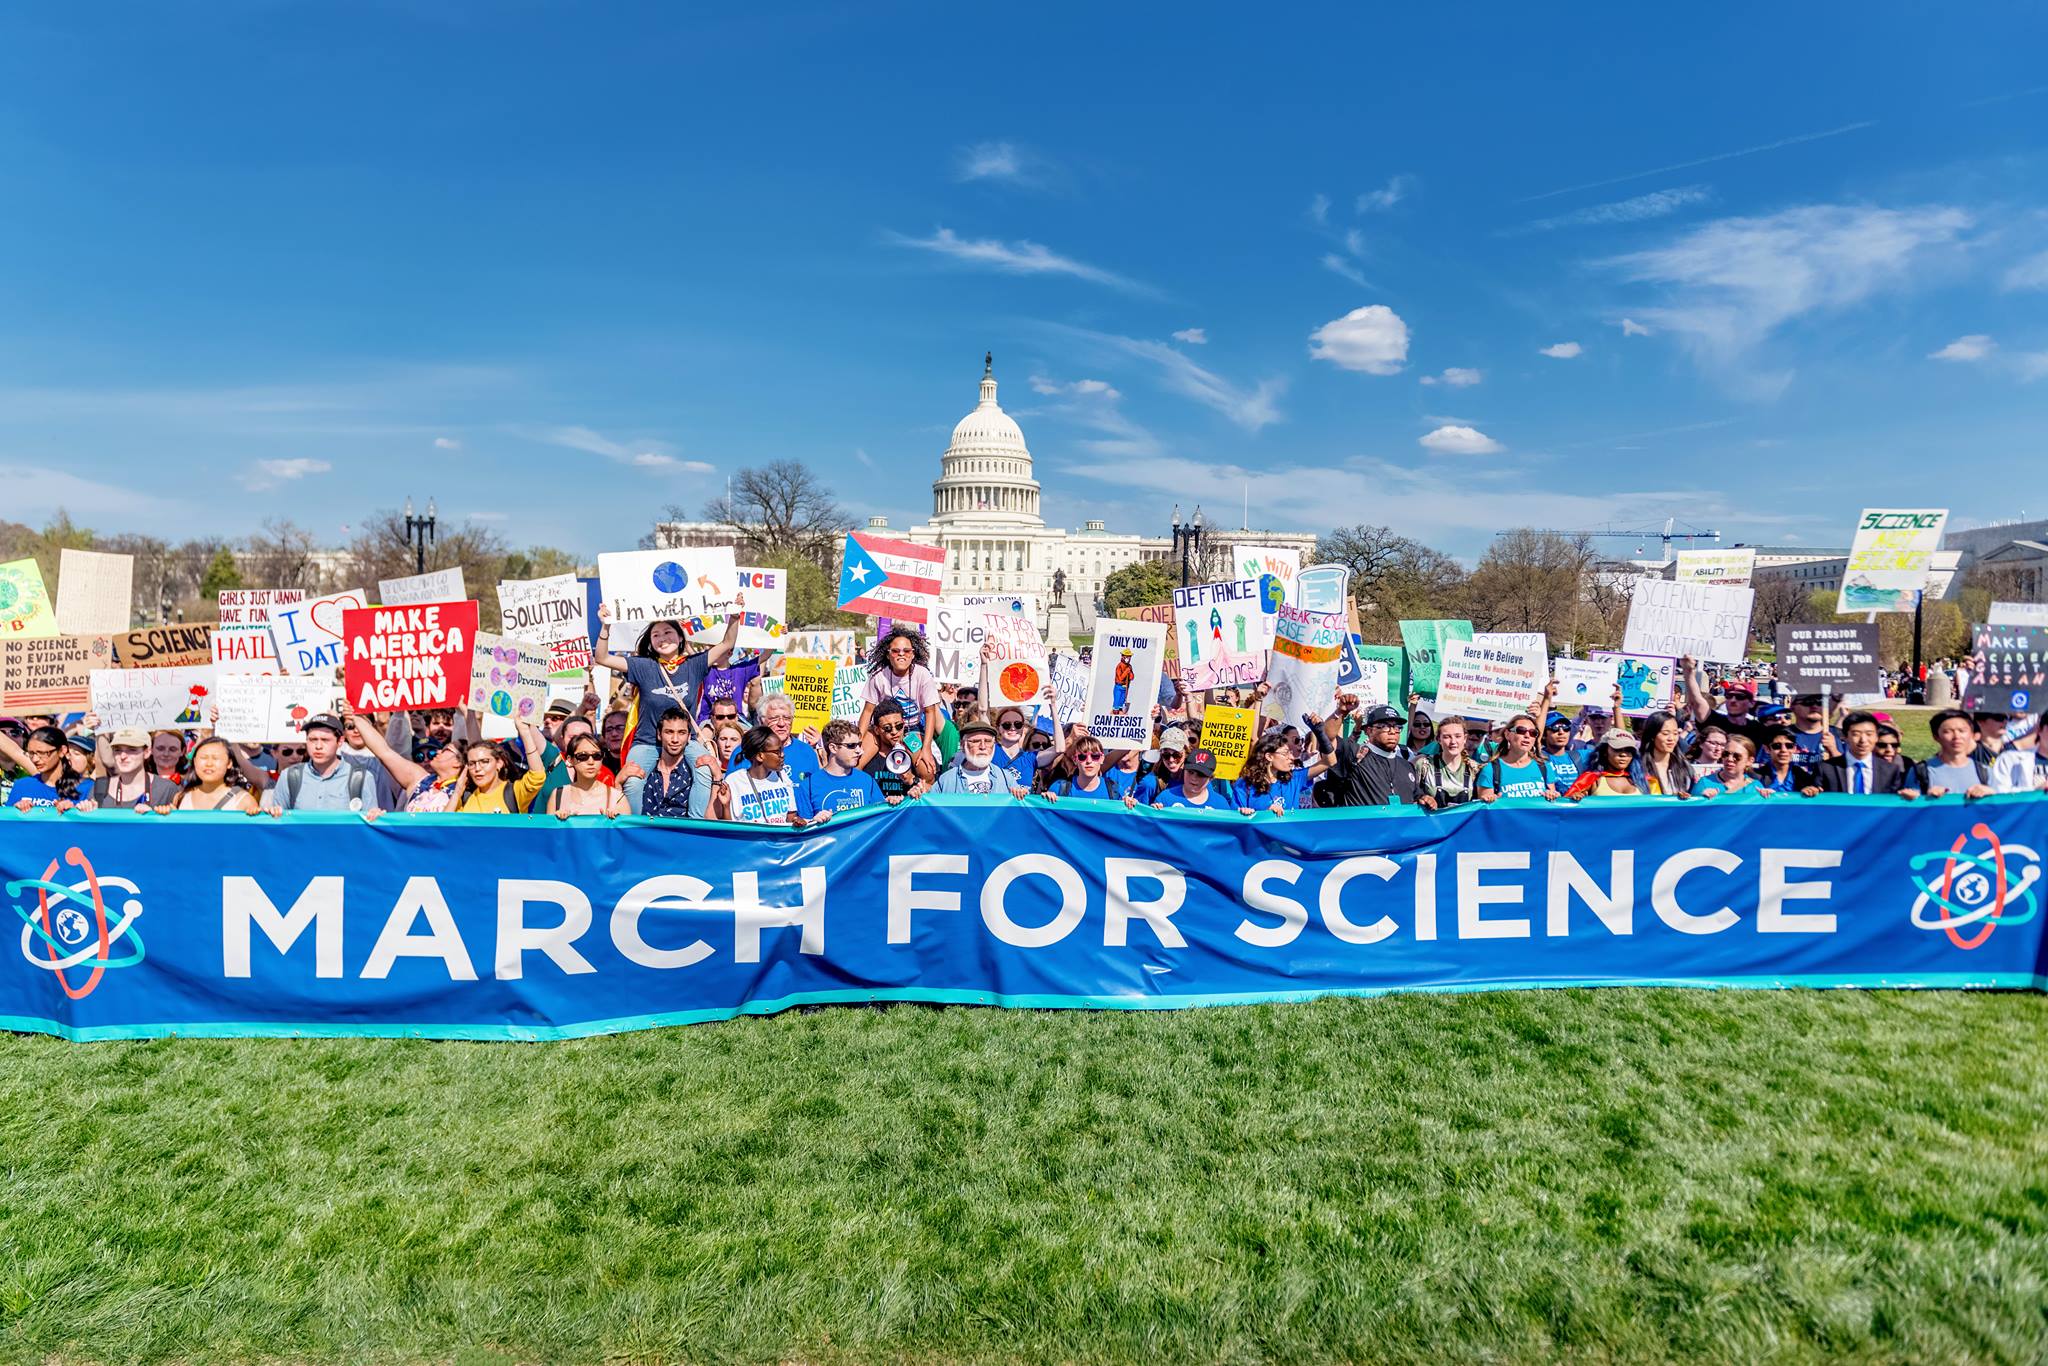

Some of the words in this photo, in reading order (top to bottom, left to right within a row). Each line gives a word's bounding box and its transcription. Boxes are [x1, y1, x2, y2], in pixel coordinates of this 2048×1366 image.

[1860, 513, 1943, 530] SCIENCE
[885, 556, 910, 572] Death
[1694, 567, 1726, 577] ABILITY
[737, 572, 776, 589] NCE
[220, 591, 245, 606] GIRLS
[250, 591, 271, 606] JUST
[874, 586, 926, 605] American
[964, 596, 993, 606] DON'T
[1175, 580, 1256, 609] DEFIANCE
[1637, 581, 1713, 612] SCIENCE
[1721, 588, 1741, 614] IS
[220, 608, 242, 623] HAVE
[503, 597, 582, 630] SOLUTION
[614, 597, 645, 622] I'm
[652, 597, 692, 619] with
[703, 594, 734, 616] her
[1141, 605, 1176, 624] GNEI
[1278, 602, 1311, 626] BREAK
[278, 610, 307, 646] I
[375, 606, 440, 635] MAKE
[937, 611, 987, 644] Scie
[1011, 616, 1035, 632] HOT
[1713, 613, 1749, 641] BEST
[1276, 618, 1306, 643] RISE
[1791, 630, 1812, 640] OUR
[1814, 629, 1857, 640] PASSION
[6, 641, 22, 652] NO
[27, 638, 78, 652] SCIENCE
[217, 636, 277, 661] HAIL
[353, 627, 465, 661] AMERICA
[1109, 635, 1131, 649] ONLY
[1132, 637, 1148, 650] YOU
[1788, 642, 1809, 652] FOR
[1812, 641, 1863, 652] LEARNING
[1977, 633, 2029, 648] MAKE
[6, 655, 22, 666] NO
[28, 650, 89, 664] EVIDENCE
[298, 641, 342, 672] DAT
[1409, 648, 1437, 664] NOT
[1464, 646, 1482, 659] Here
[1483, 648, 1495, 661] We
[1496, 650, 1524, 665] Believe
[1786, 655, 1798, 665] IS
[1801, 655, 1823, 664] OUR
[1824, 654, 1850, 664] TOOL
[1852, 654, 1873, 664] FOR
[5, 668, 21, 678] NO
[27, 664, 65, 676] TRUTH
[370, 656, 444, 681] THINK
[1208, 655, 1259, 685] Science!
[1448, 659, 1461, 668] Love
[1468, 662, 1480, 671] Love
[1799, 667, 1851, 678] SURVIVAL
[1975, 662, 2041, 674] GREAT
[4, 680, 21, 691] NO
[26, 675, 91, 690] DEMOCRACY
[94, 669, 182, 689] SCIENCE
[785, 674, 816, 684] UNITED
[1051, 671, 1087, 702] RISING
[1447, 670, 1460, 679] Black
[1461, 672, 1474, 681] Lives
[1475, 674, 1492, 683] Matter
[1496, 677, 1514, 687] Science
[1521, 680, 1532, 689] Real
[96, 690, 143, 701] MAKES
[358, 676, 447, 709] AGAIN
[790, 683, 831, 694] NATURE.
[832, 685, 854, 703] ER
[1445, 682, 1466, 692] Women's
[1468, 685, 1484, 695] Rights
[1486, 688, 1494, 696] are
[1495, 688, 1513, 698] Human
[1514, 690, 1530, 701] Rights
[95, 697, 162, 711] AMERICA
[790, 693, 815, 703] UIDED
[816, 695, 828, 703] BY
[1476, 698, 1497, 707] Kindness
[1504, 701, 1528, 711] Everythin
[1621, 696, 1669, 710] ENCE
[794, 702, 829, 712] CIENCE.
[831, 700, 861, 717] ONTHS
[100, 711, 158, 728] GREAT
[1094, 714, 1113, 727] CAN
[1114, 715, 1143, 728] RESIST
[1205, 722, 1235, 731] UNITED
[1236, 723, 1248, 732] BY
[1087, 726, 1121, 738] FASCIST
[1121, 727, 1147, 740] LIARS
[1209, 730, 1249, 741] NATURE.
[1202, 739, 1233, 749] GUIDED
[1234, 741, 1246, 750] BY
[1207, 747, 1247, 759] SCIENCE.
[1501, 781, 1536, 793] UNITED
[1507, 789, 1543, 798] NATUR
[741, 789, 775, 806] MARCH
[222, 867, 826, 982] MARCH
[886, 853, 1188, 949] FOR
[1234, 847, 1843, 948] SCIENCE
